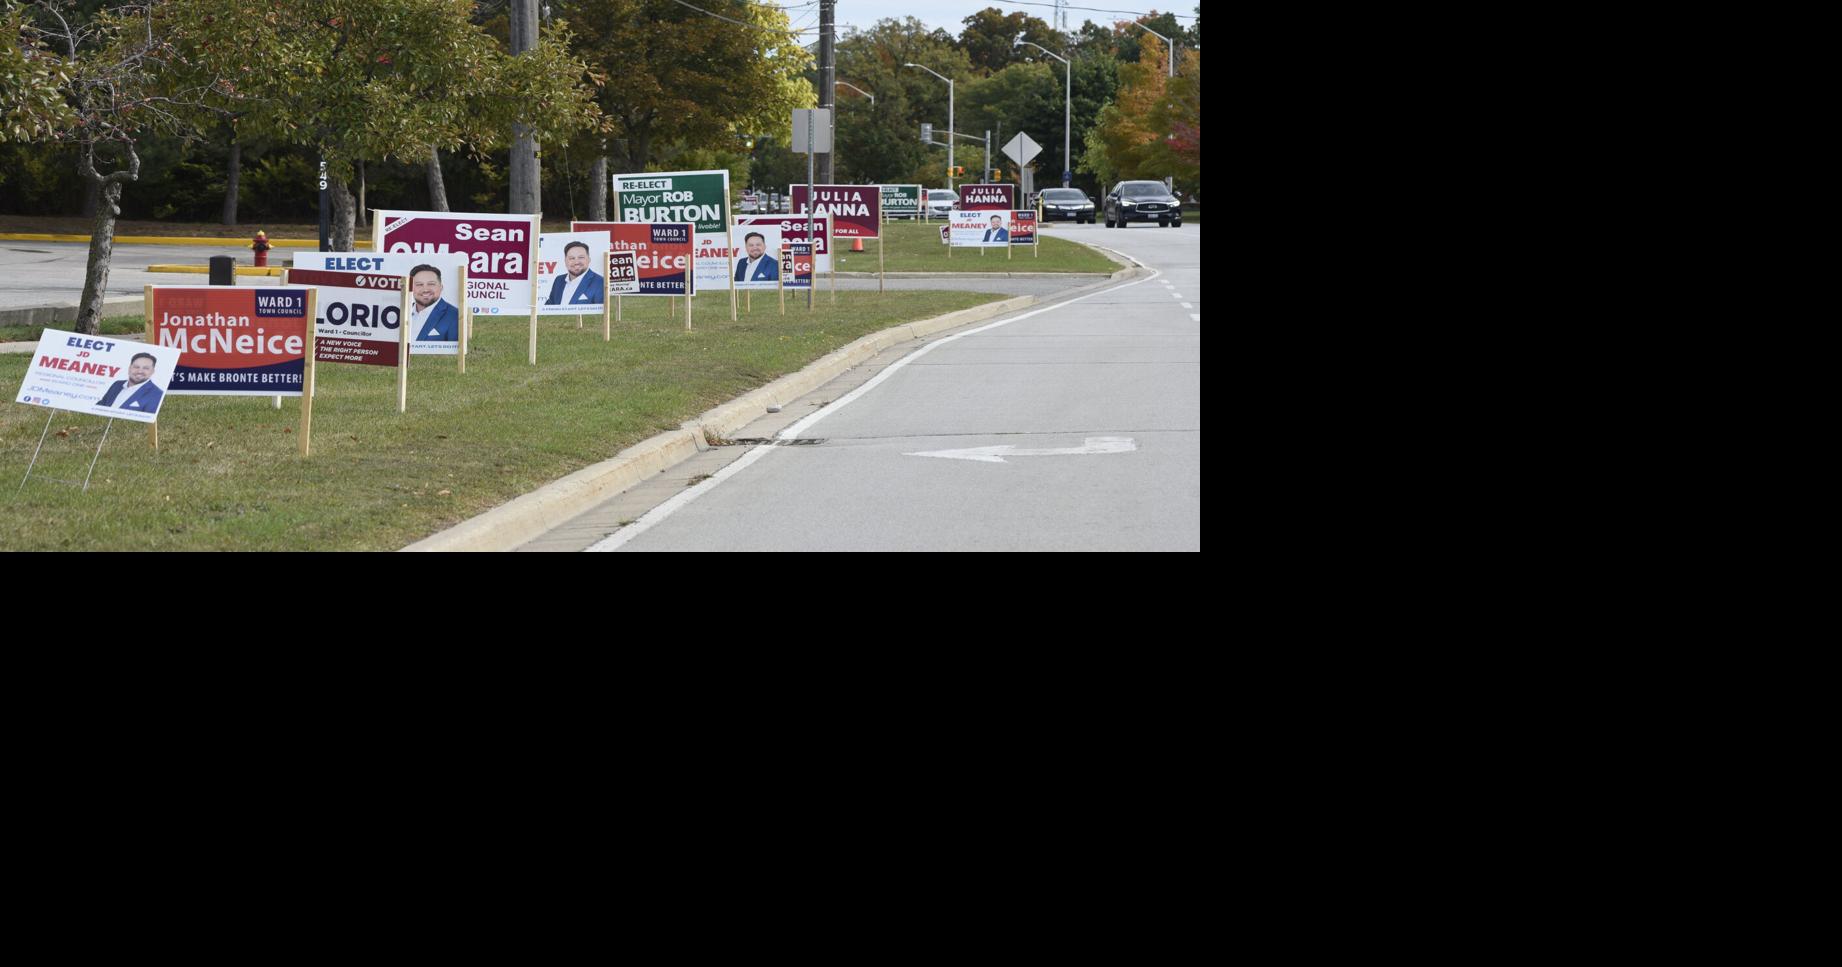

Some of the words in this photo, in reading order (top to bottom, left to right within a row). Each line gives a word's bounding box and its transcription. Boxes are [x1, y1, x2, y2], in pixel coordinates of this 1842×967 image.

[622, 181, 666, 190] RE-ELECT
[623, 194, 661, 207] Mayor
[663, 190, 694, 202] ROB
[813, 192, 862, 202] JULIA
[966, 195, 1007, 203] HANNA
[624, 204, 720, 223] BURTON
[781, 220, 824, 232] Sean
[1010, 222, 1034, 232] eice
[455, 223, 524, 242] Sean
[610, 240, 646, 250] athan
[696, 248, 740, 258] ANEY
[325, 257, 384, 271] ELECT
[610, 256, 632, 264] ean
[637, 250, 686, 269] eice
[467, 282, 510, 290] GIONAL
[467, 290, 506, 300] UNCIL
[258, 296, 292, 308] WARD
[297, 297, 301, 307] 1
[160, 312, 250, 327] Jonathan
[316, 301, 401, 329] ORIO
[67, 337, 115, 352] ELECT
[160, 327, 303, 355] McNeice
[39, 356, 121, 378] MEANEY
[171, 372, 185, 382] T'S
[188, 372, 216, 383] MAKE
[219, 373, 258, 383] BRONTE
[262, 374, 302, 384] BETTER!
